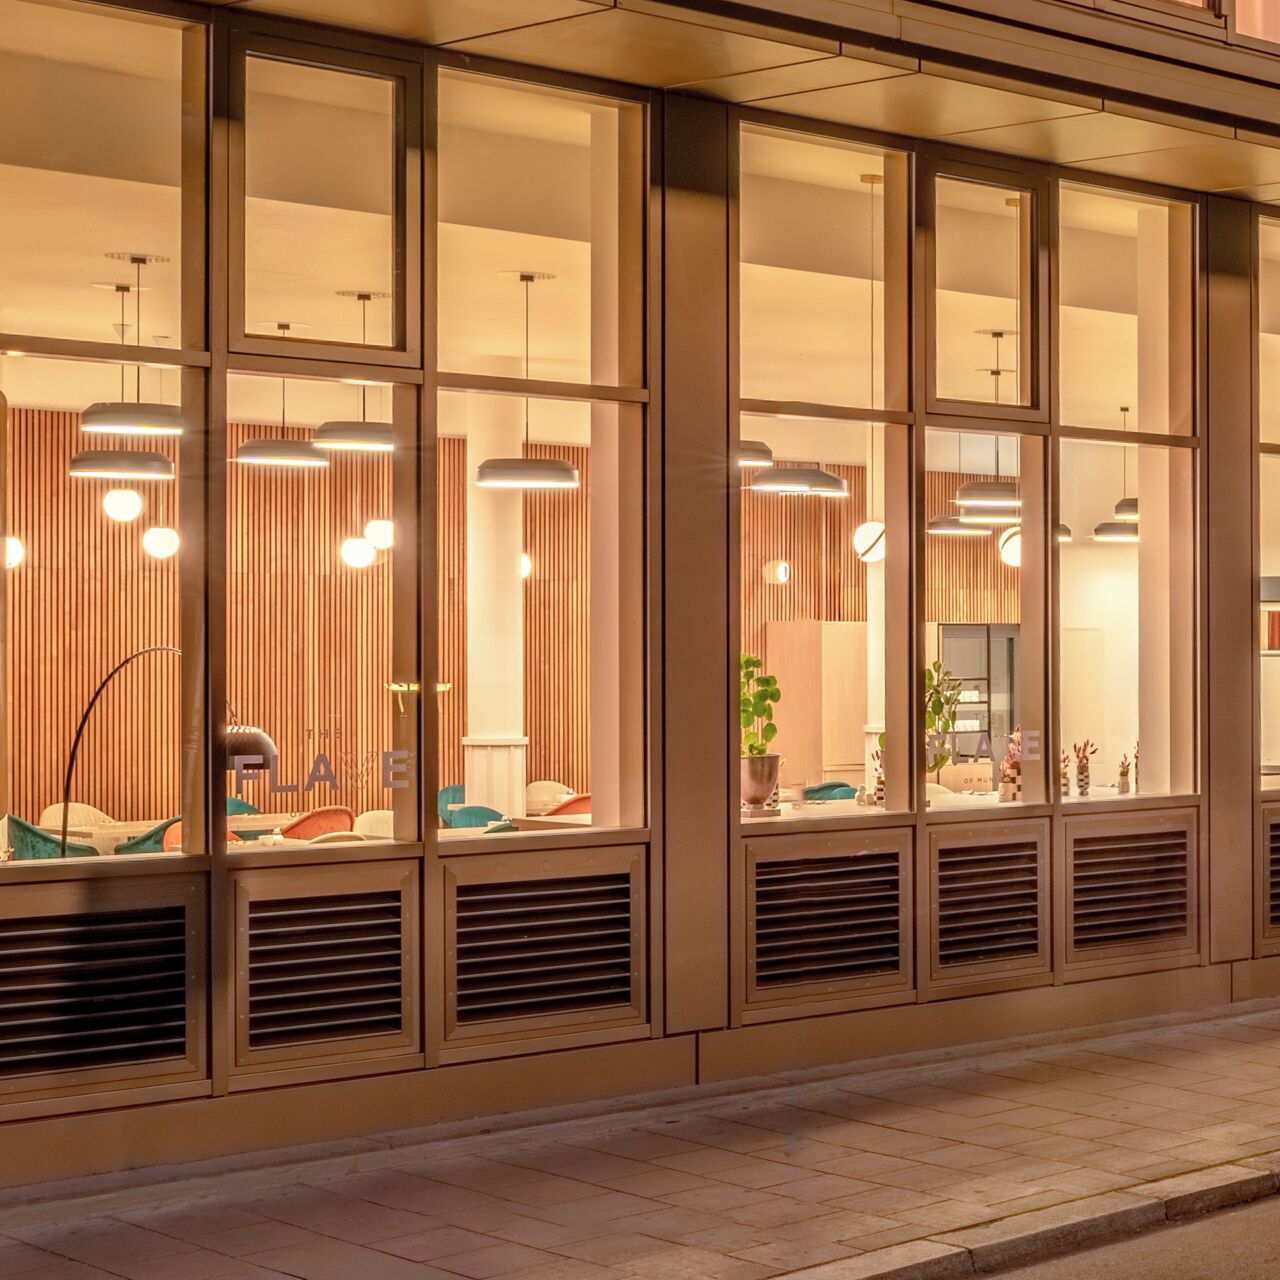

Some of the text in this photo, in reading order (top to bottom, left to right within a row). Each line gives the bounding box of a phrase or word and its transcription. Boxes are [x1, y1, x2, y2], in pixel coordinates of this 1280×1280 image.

[306, 728, 342, 739] THE
[234, 750, 410, 795] FLAVE
[963, 777, 974, 785] OF
